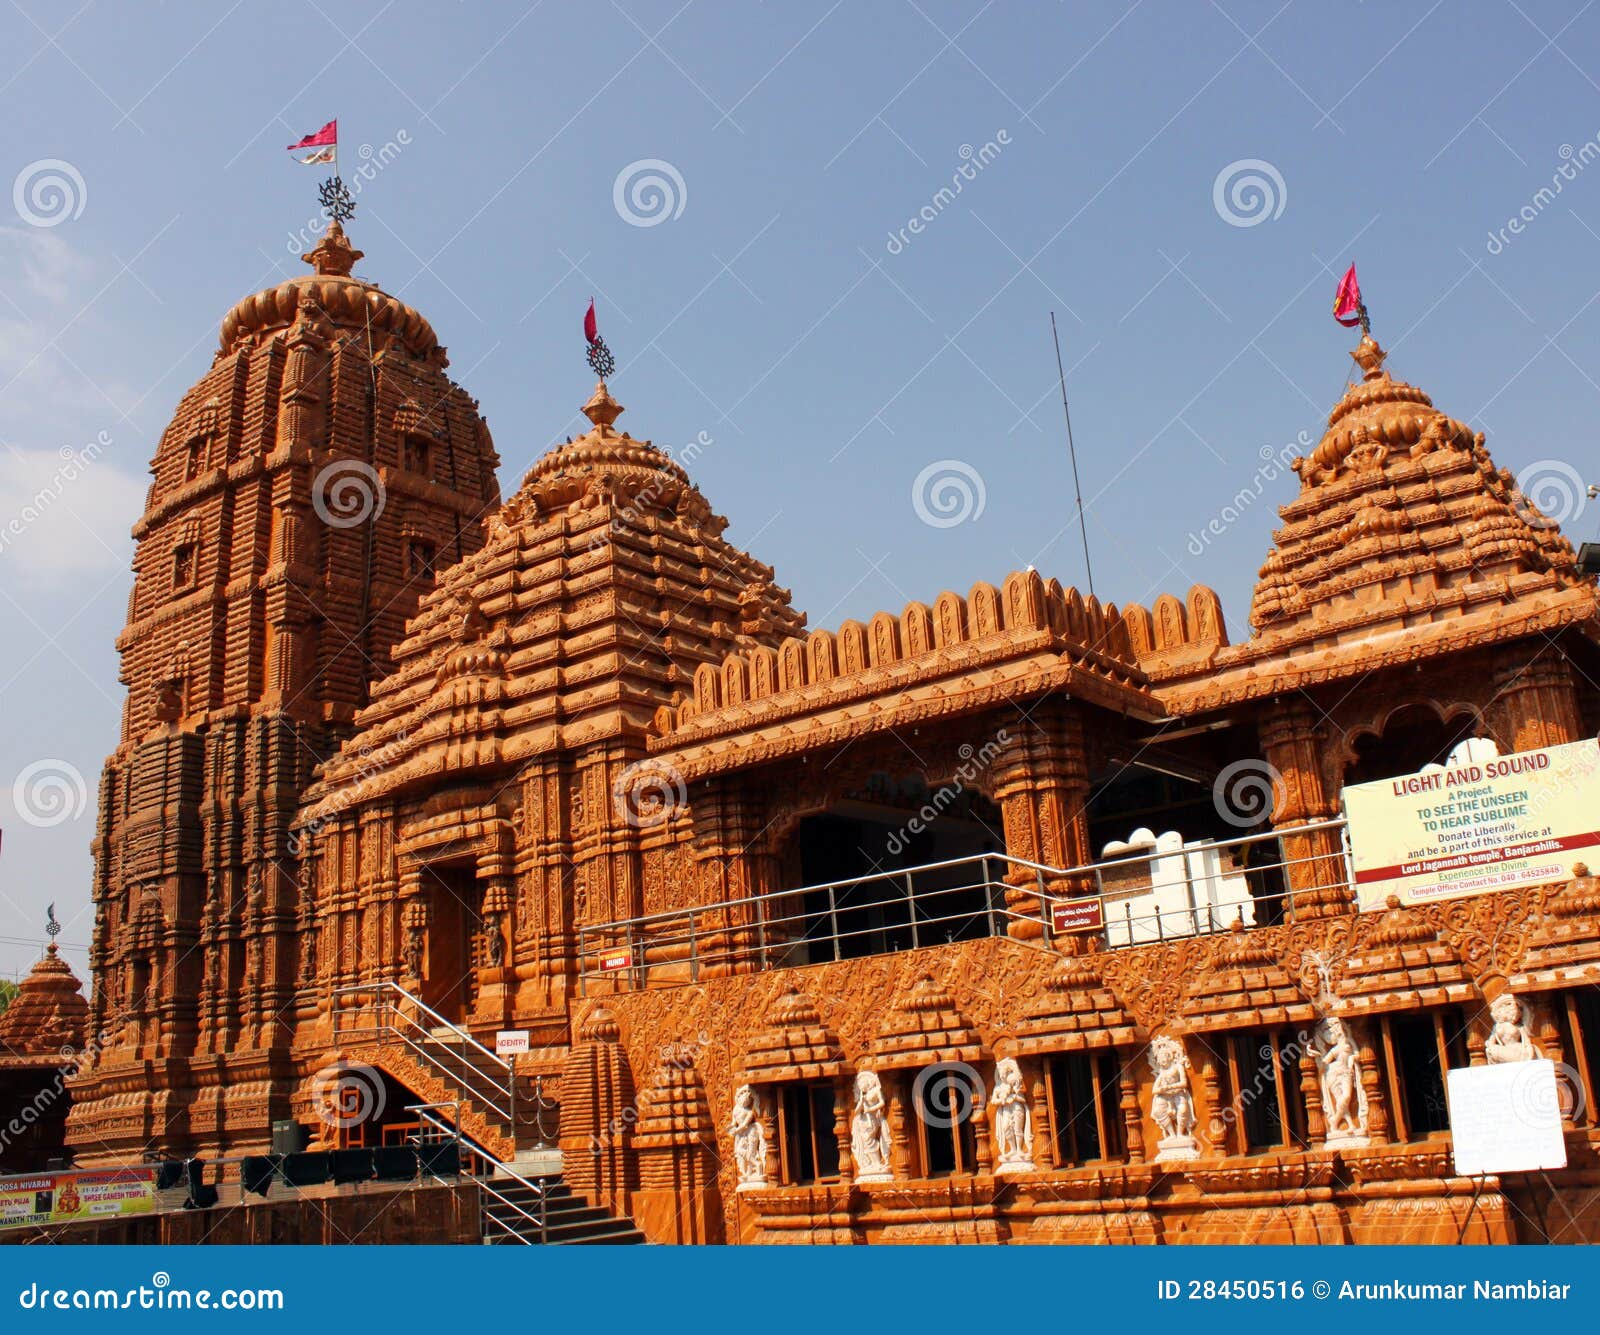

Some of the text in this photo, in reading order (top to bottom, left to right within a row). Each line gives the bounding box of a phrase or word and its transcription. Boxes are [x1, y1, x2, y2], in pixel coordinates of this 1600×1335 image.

[1393, 753, 1550, 796] LIGHT AND SOUND
[1418, 791, 1528, 819] TO SEE THE UNSEEN
[1449, 785, 1492, 801] A Project
[1423, 805, 1527, 832] TO HEAR SUBLIME
[1408, 826, 1552, 859] and be a part of this service at
[1438, 822, 1516, 843] Donate Liberally
[1402, 841, 1563, 874] Lord Jagannath temple, Banjarahills.
[1439, 860, 1527, 881] Experience the Divine
[1411, 886, 1435, 897] Temple
[1437, 882, 1458, 892] Office
[1459, 878, 1486, 890] Contact
[1488, 876, 1500, 885] No.
[1501, 873, 1516, 883] 040
[606, 957, 625, 968] HUNDI
